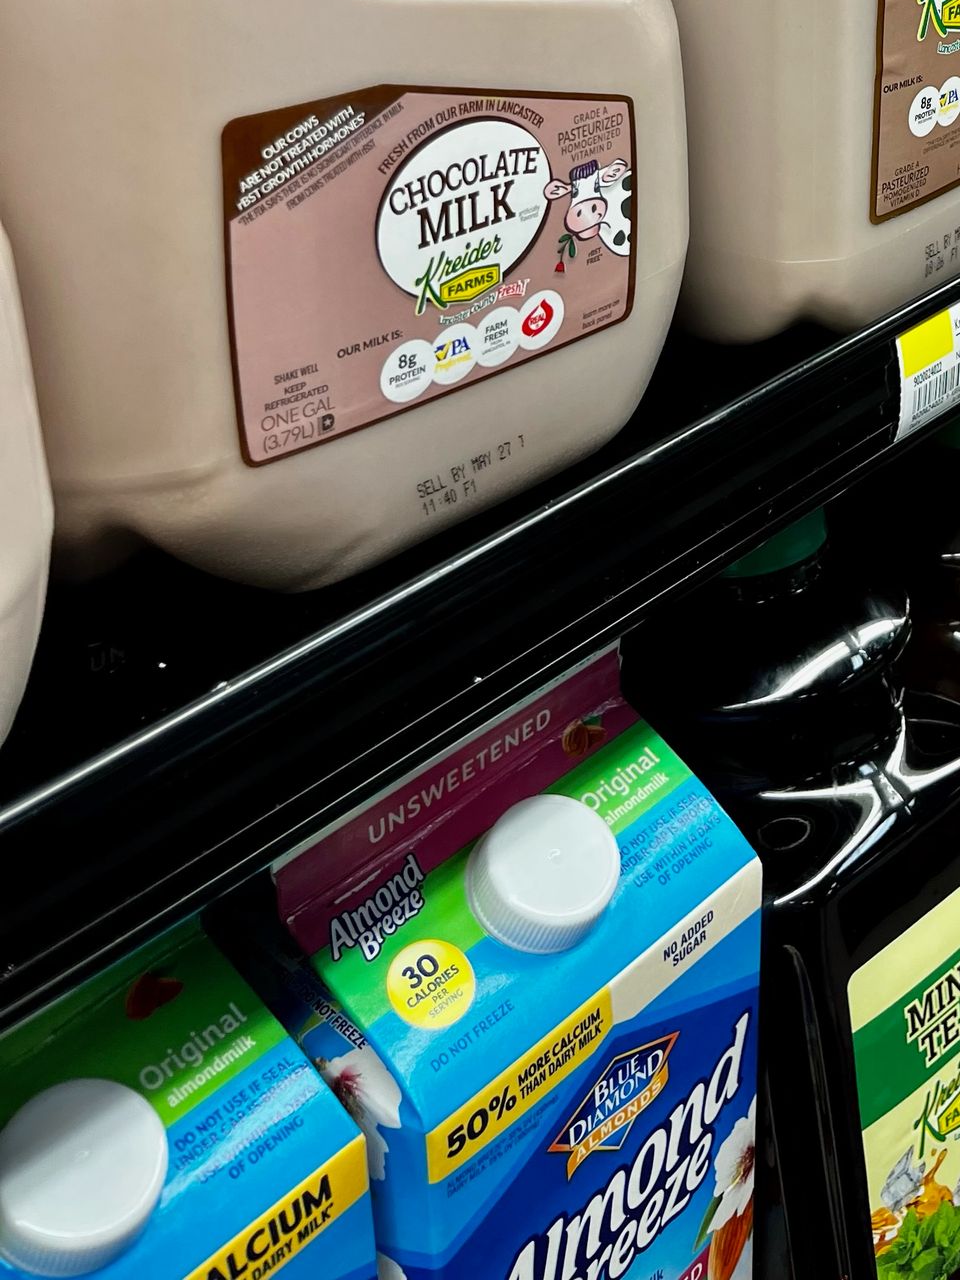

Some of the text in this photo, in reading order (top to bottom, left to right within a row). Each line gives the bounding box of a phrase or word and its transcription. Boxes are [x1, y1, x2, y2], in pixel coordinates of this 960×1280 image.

[882, 73, 924, 95] OUR MILK IS:
[920, 95, 932, 111] 8g
[948, 89, 960, 103] PA
[377, 99, 545, 175] FRESH FROM OUR FARM IN LANCASTER
[557, 113, 624, 146] PASTEURIZED
[574, 106, 608, 125] GRADE A
[914, 107, 937, 122] PROTEIN
[240, 105, 355, 193] ARE NOT TREATED WITH
[262, 115, 319, 160] OUR COWS
[561, 127, 621, 156] HOMOGENIZED
[571, 141, 613, 162] VITAMIN D
[389, 147, 540, 216] CHOCOLATE
[881, 165, 930, 194] PASTEURIZED
[883, 178, 927, 202] HOMOGENIZED
[417, 180, 517, 250] MILK
[415, 234, 503, 315] Kreider
[447, 271, 495, 298] FARMS
[337, 329, 404, 360] OUR MILK IS:
[451, 335, 472, 356] PA
[484, 327, 510, 344] FRESH
[485, 319, 509, 335] FARM
[274, 363, 319, 385] SHAKE WELL
[389, 365, 427, 387] PROTEIN
[398, 353, 417, 370] 8g
[264, 384, 329, 412] REFRIGERATED
[284, 381, 307, 395] KEEP
[260, 396, 336, 432] ONE GAL
[263, 421, 315, 454] (3.79L)
[367, 708, 552, 845] UNSWEETENED
[580, 746, 661, 810] Original
[605, 771, 670, 826] almondmilk
[633, 813, 722, 889] USE WITHIN 14 DAYS
[658, 838, 713, 887] OF OPENING
[330, 854, 425, 962] Almond
[357, 889, 424, 962] Breeze
[663, 909, 715, 963] NO ADDED
[671, 930, 708, 968] SUGAR
[401, 953, 440, 990] 30
[406, 964, 460, 1009] CALORIES
[428, 988, 464, 1019] SERVING
[432, 987, 449, 1004] PER
[312, 996, 336, 1023] NOT
[333, 1010, 368, 1050] FREEZE
[430, 999, 516, 1072] DO NOT FREEZE
[139, 1002, 248, 1091] Original
[517, 1007, 602, 1087] MORE CALCIUM
[167, 1033, 257, 1108] almondmilk
[594, 1053, 642, 1110] BLUE
[174, 1056, 295, 1153] DO NOT USE IF SEAL
[568, 1049, 665, 1150] DIAMOND
[575, 1076, 663, 1163] ALMONDS
[447, 1085, 518, 1160] 50%
[228, 1114, 305, 1180] OF OPENING
[506, 1012, 749, 1280] Almond
